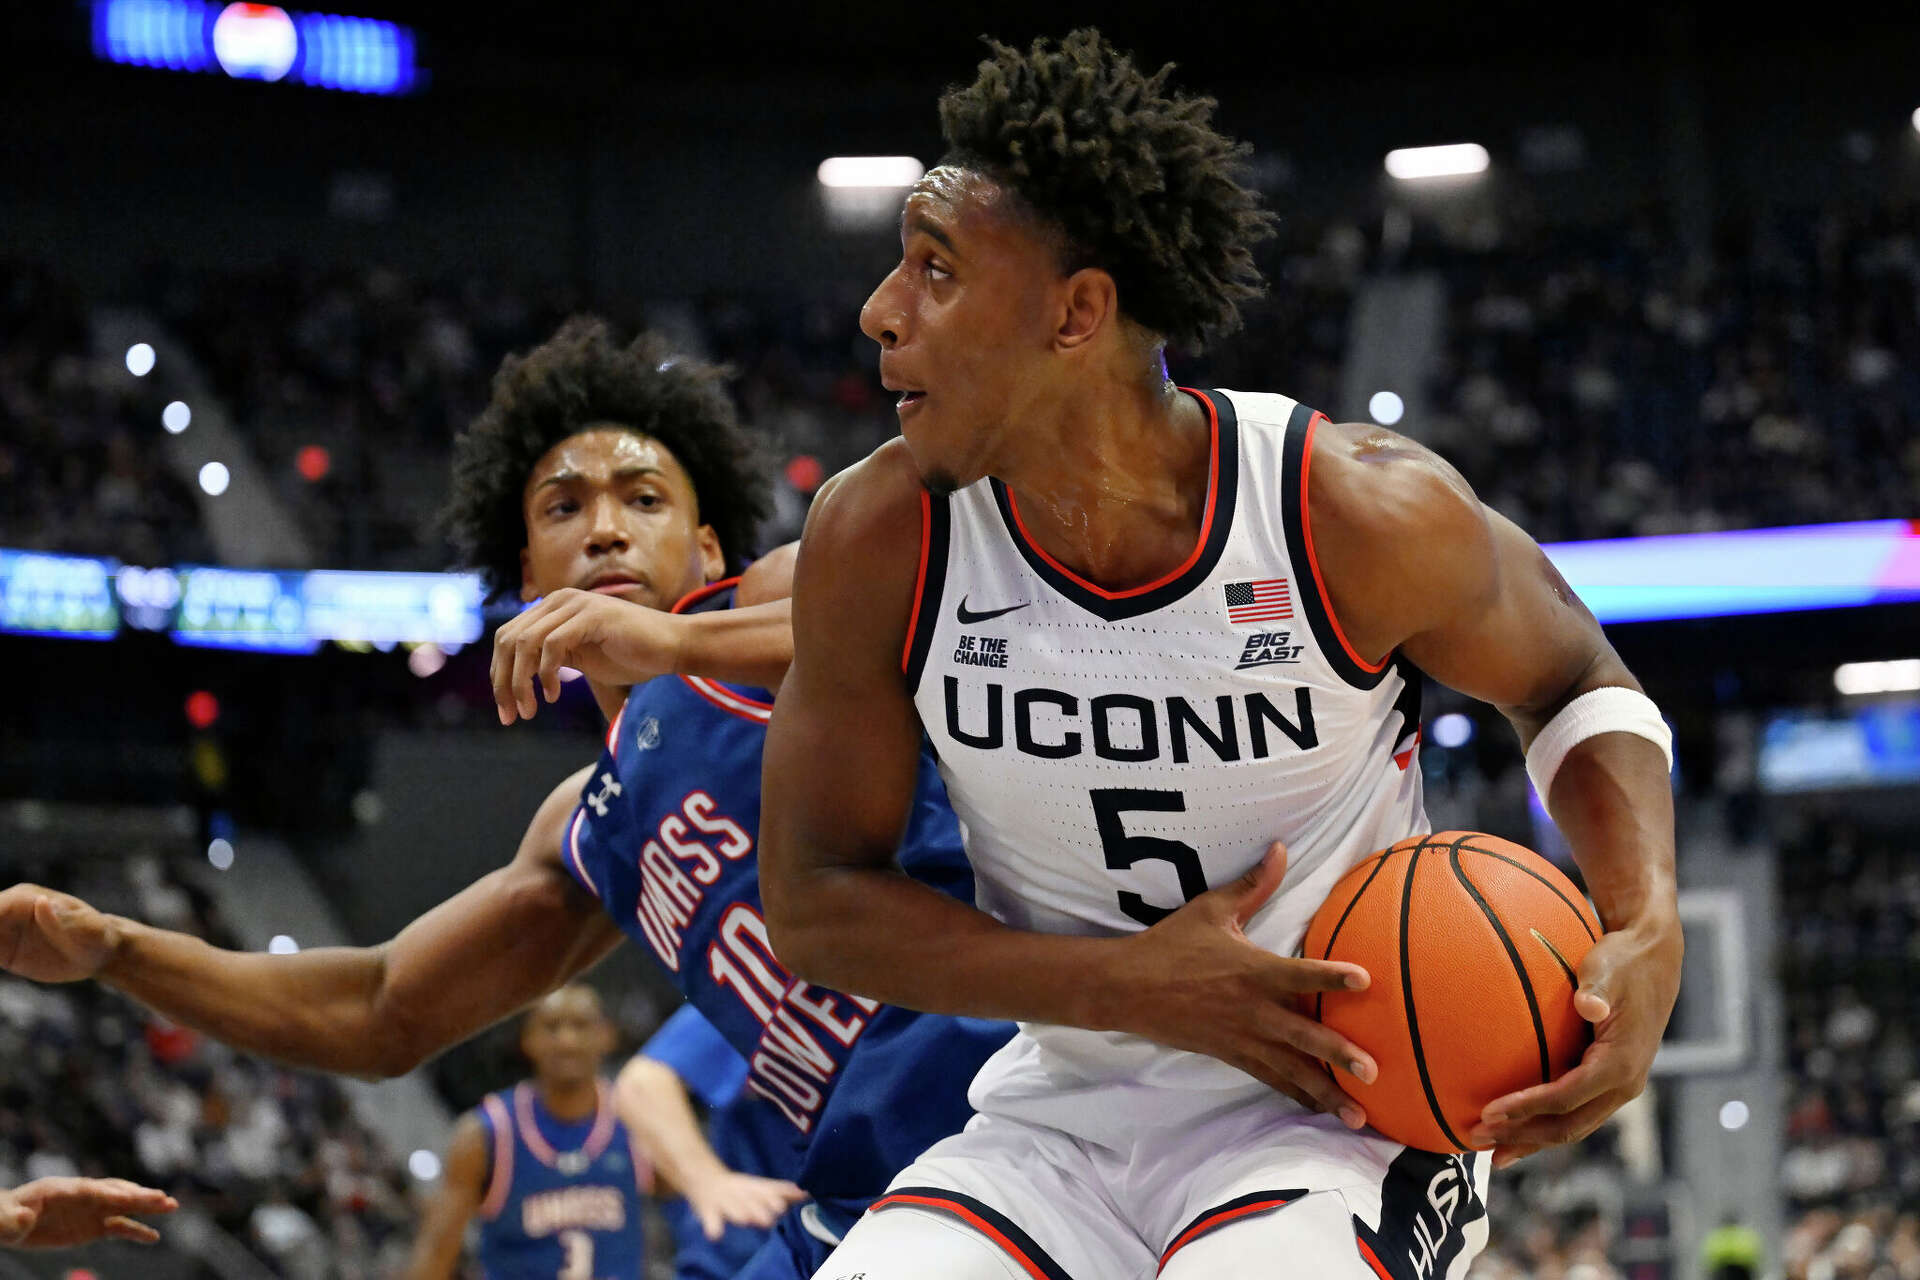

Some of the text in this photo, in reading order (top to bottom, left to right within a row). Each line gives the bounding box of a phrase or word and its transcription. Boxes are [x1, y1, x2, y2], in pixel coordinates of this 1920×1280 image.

[959, 635, 1008, 653] BE THE
[1245, 632, 1291, 649] BIG
[954, 649, 1009, 668] CHANGE
[1239, 646, 1304, 663] EAST
[944, 674, 1319, 764] UCONN
[1089, 787, 1210, 927] 5
[636, 789, 753, 972] UMASS
